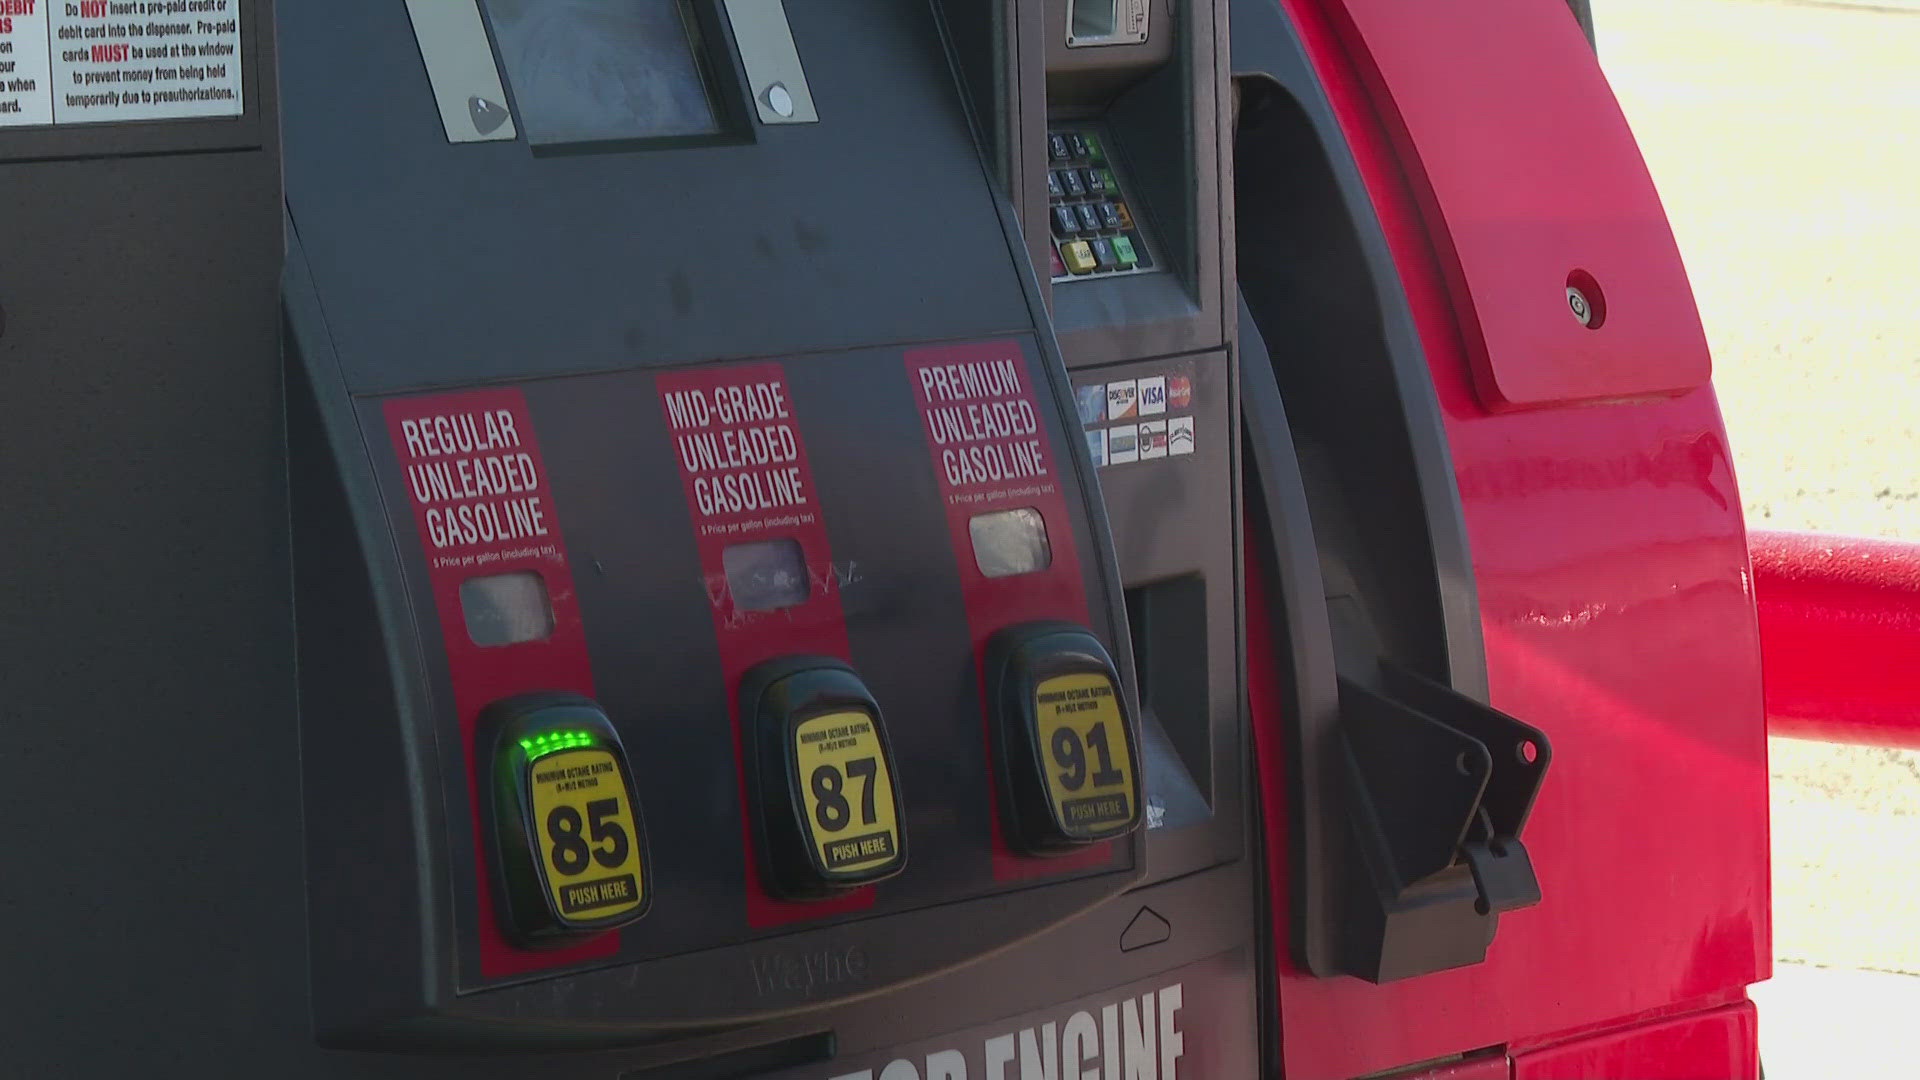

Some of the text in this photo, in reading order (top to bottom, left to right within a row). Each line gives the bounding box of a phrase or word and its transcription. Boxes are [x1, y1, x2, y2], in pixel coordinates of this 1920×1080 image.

[65, 0, 226, 18] Do NOT insert a pre-paid credit or
[0, 17, 12, 33] S
[58, 18, 236, 40] debit card into the dispenser. Pre-paid
[62, 41, 233, 63] cards MUST be used at the window
[8, 78, 35, 92] when
[73, 63, 226, 86] to prevent money from being held
[0, 99, 21, 113] ard.
[66, 86, 234, 109] temporarily due to preauthorizations.
[919, 359, 1021, 403] PREMIUM
[665, 381, 789, 429] MID-GRADE
[1142, 386, 1164, 406] VISA
[401, 409, 520, 458] REGULAR
[926, 399, 1037, 445] UNLEADED
[678, 425, 797, 473] UNLEADED
[942, 440, 1047, 487] GASOLINE
[408, 452, 538, 504] UNLEADED
[694, 467, 806, 517] GASOLINE
[426, 497, 548, 549] GASOLINE
[707, 523, 726, 534] Price
[727, 522, 739, 534] per
[741, 520, 763, 533] gallon
[764, 515, 800, 529] (including
[800, 512, 815, 524] tax)
[440, 556, 460, 567] Price
[462, 556, 475, 566] per
[476, 552, 500, 565] gallon
[501, 547, 540, 561] (including
[540, 544, 556, 555] tax)
[1051, 721, 1124, 792] 91
[566, 765, 591, 779] OCTANE
[811, 757, 877, 832] 87
[1070, 801, 1122, 820] PUSH HERE
[547, 797, 629, 876] 85
[832, 837, 887, 861] PUSH HERE
[568, 880, 628, 907] PUSH HERE
